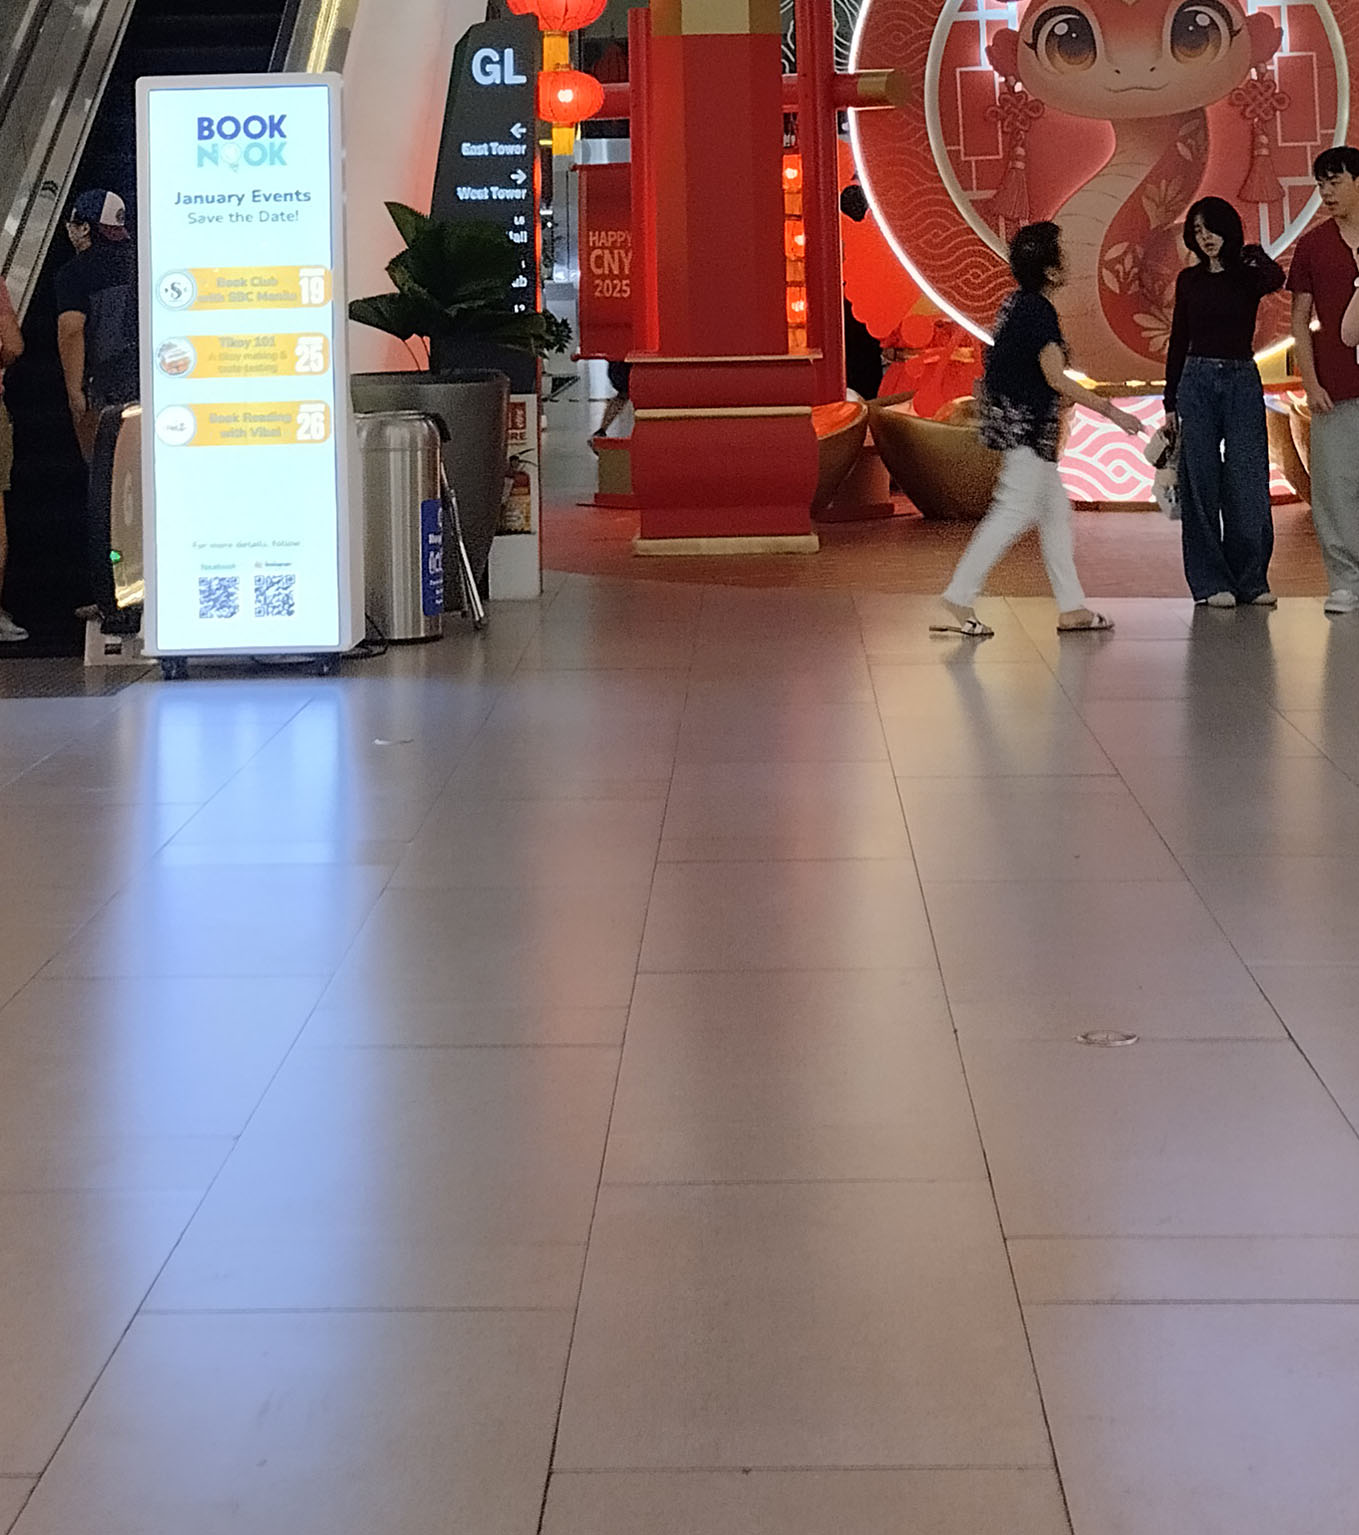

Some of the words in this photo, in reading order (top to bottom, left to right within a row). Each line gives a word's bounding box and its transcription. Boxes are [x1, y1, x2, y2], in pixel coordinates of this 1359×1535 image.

[472, 47, 527, 85] GL
[197, 114, 287, 141] BOOK
[461, 142, 489, 156] East
[490, 142, 527, 155] Tower
[174, 191, 245, 206] January
[252, 189, 311, 202] Events
[456, 186, 489, 200] West
[490, 186, 527, 200] Tower
[188, 212, 224, 224] Save
[229, 211, 253, 223] the
[259, 210, 299, 222] Date!
[589, 231, 632, 247] HAPPY
[590, 249, 632, 275] CNY
[217, 277, 247, 287] Book
[251, 277, 278, 287] Club
[299, 277, 324, 304] 19
[594, 279, 630, 297] 2025
[295, 344, 324, 372] 25
[209, 414, 240, 423] Book
[296, 412, 324, 440] 26
